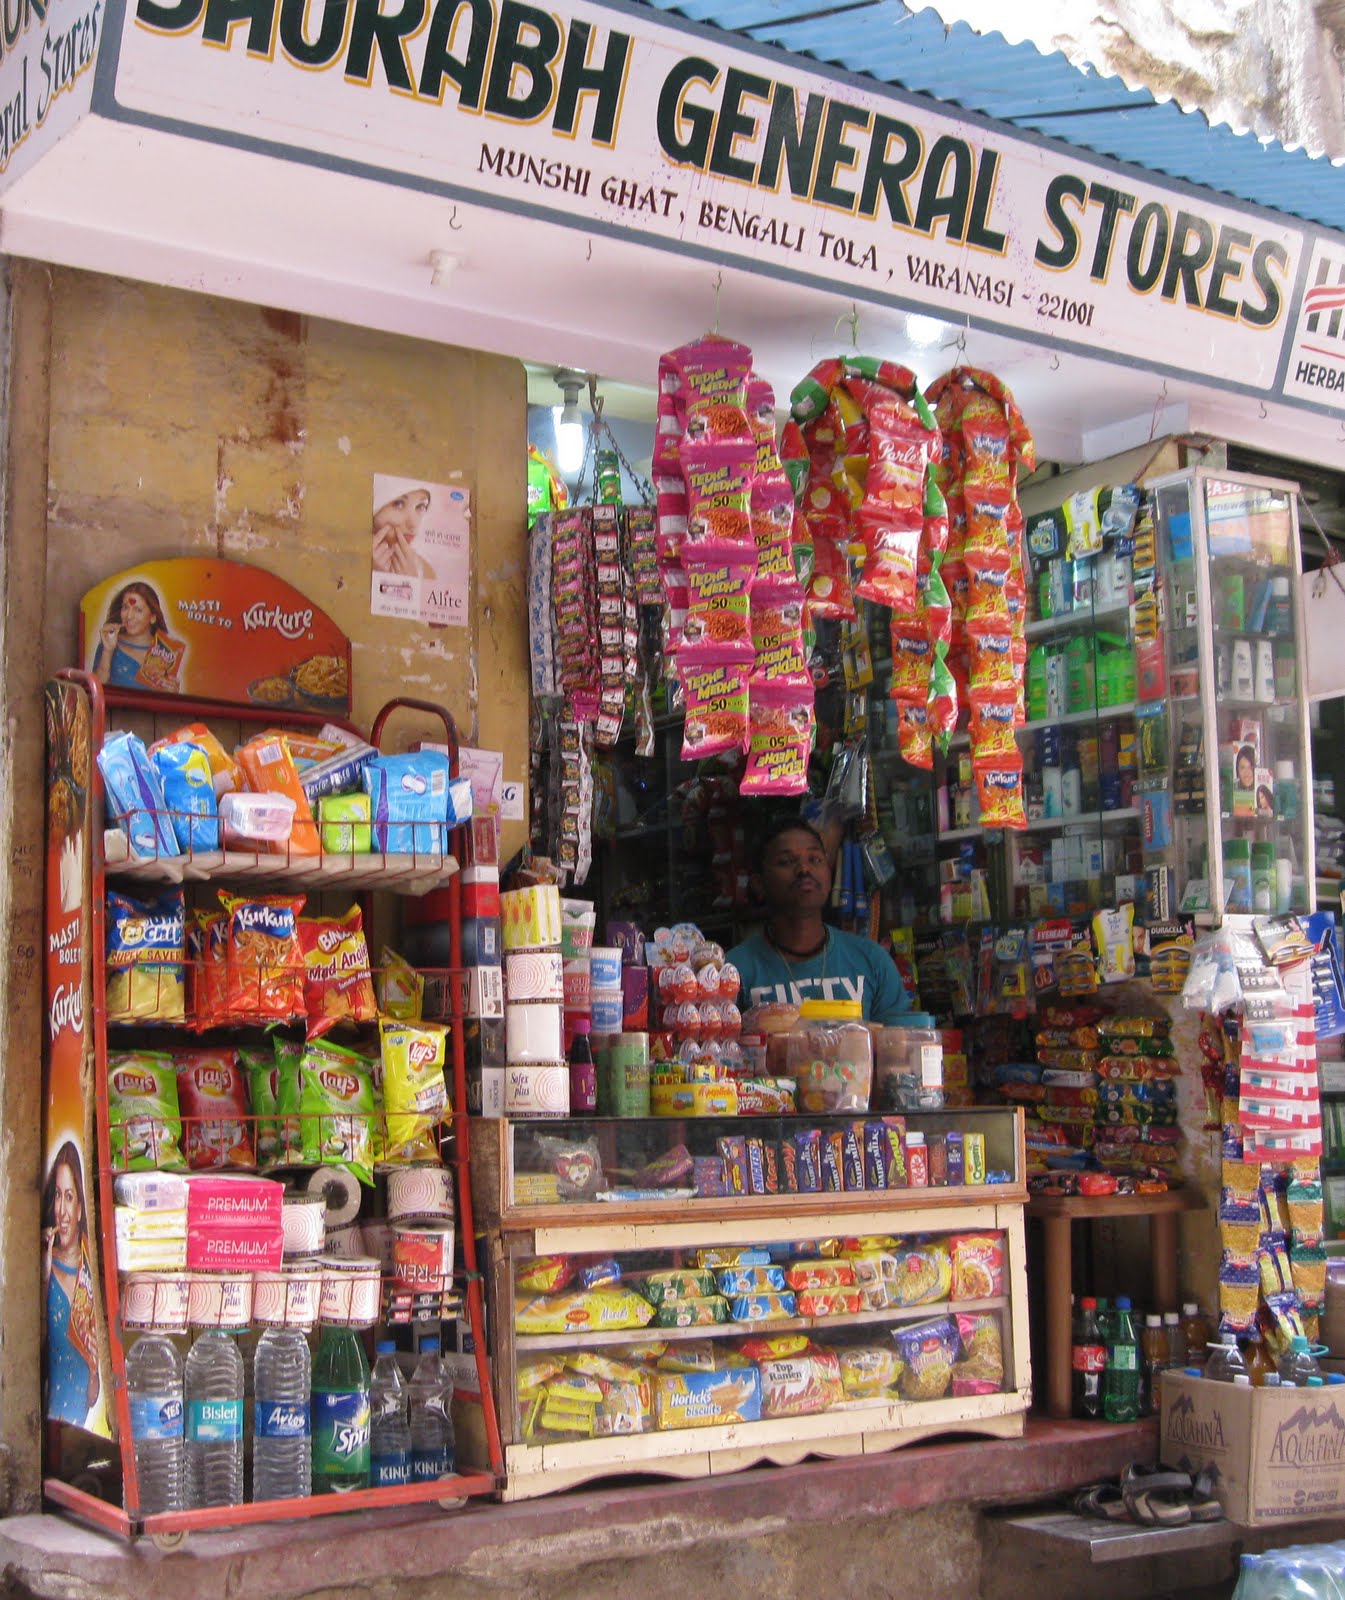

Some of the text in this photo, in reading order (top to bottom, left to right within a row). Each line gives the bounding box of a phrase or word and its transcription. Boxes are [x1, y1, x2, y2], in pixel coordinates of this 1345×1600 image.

[37, 1, 101, 121] Stores
[656, 56, 1009, 257] GENERAL
[1034, 174, 1289, 331] STORES
[477, 143, 591, 197] MUNSHI
[699, 201, 804, 254] BENGALI
[906, 253, 1015, 308] VARANASI
[1037, 294, 1095, 328] 221001
[178, 600, 221, 612] MASTI
[187, 612, 233, 628] BOLE TO
[242, 602, 314, 639] Kurkure
[49, 921, 80, 953] MASTI
[1151, 926, 1184, 935] DURACELL
[49, 982, 83, 1041] Kurku
[749, 1145, 763, 1193] SNICKERS
[208, 1197, 269, 1212] PREMIUM
[207, 1239, 268, 1255] PREMIUM
[769, 1371, 802, 1382] Ramen
[774, 1363, 792, 1373] Top
[670, 1389, 713, 1407] Horlicks
[163, 1401, 180, 1420] YES
[685, 1405, 722, 1417] biscuits
[336, 1427, 370, 1452] Spri
